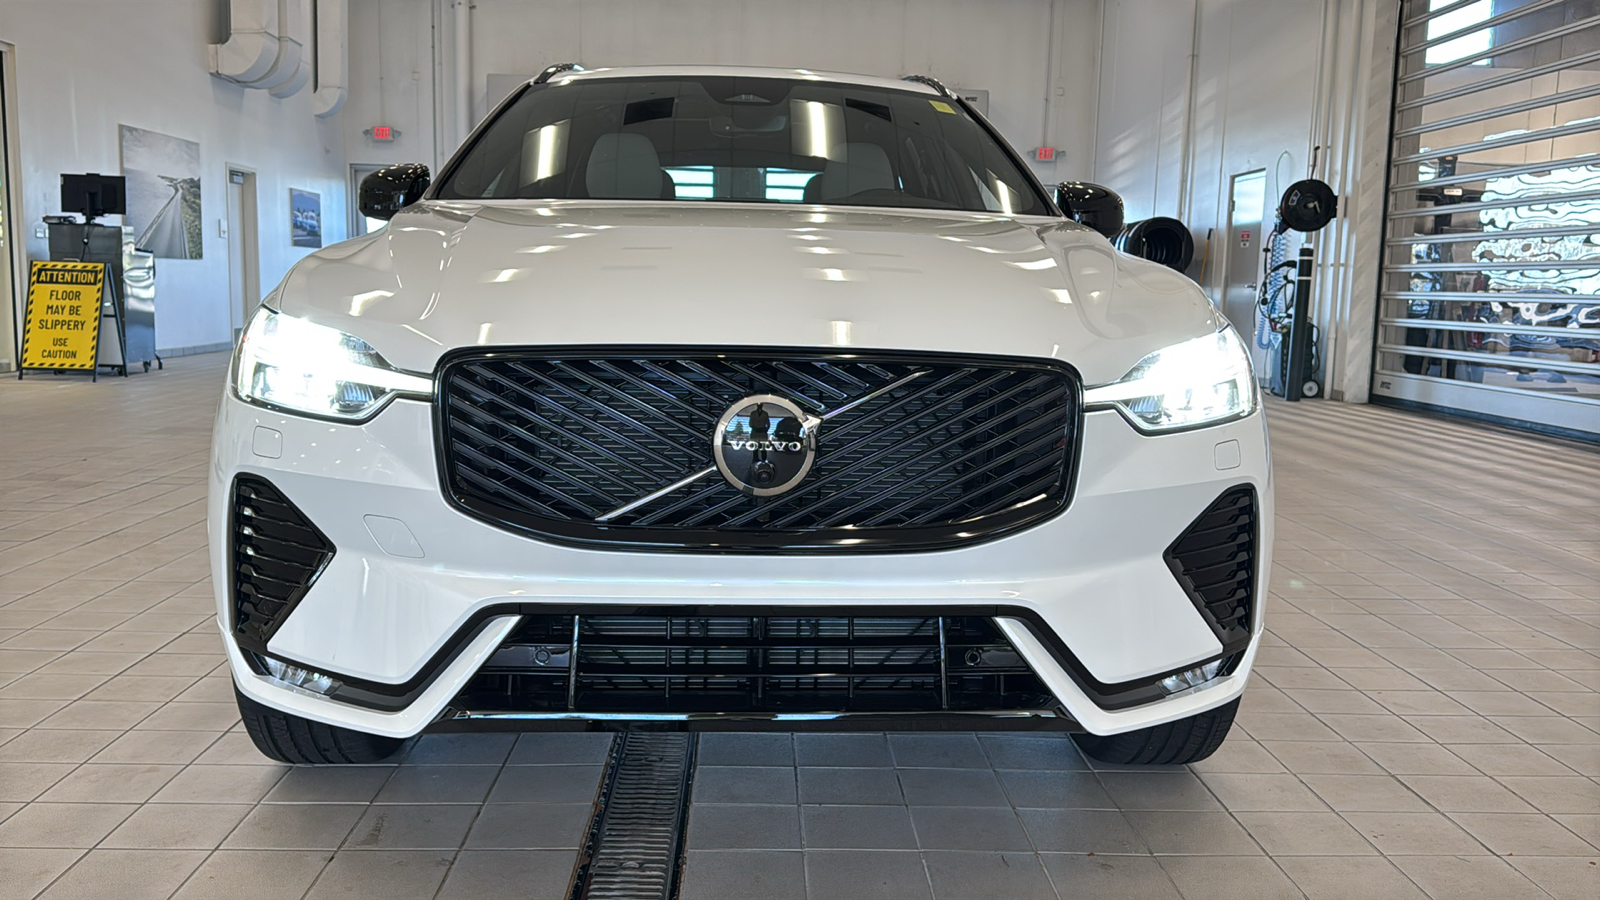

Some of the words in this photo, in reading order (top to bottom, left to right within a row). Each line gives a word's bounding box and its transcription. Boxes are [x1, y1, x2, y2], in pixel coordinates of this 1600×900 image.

[38, 271, 94, 284] ATTENTION
[50, 290, 80, 301] FLOOR
[46, 305, 66, 316] MAY
[68, 305, 82, 316] BE
[38, 319, 86, 331] SLIPPERY
[52, 338, 68, 346] USE
[41, 350, 77, 359] CAUTION
[728, 440, 801, 452] VOLVO
